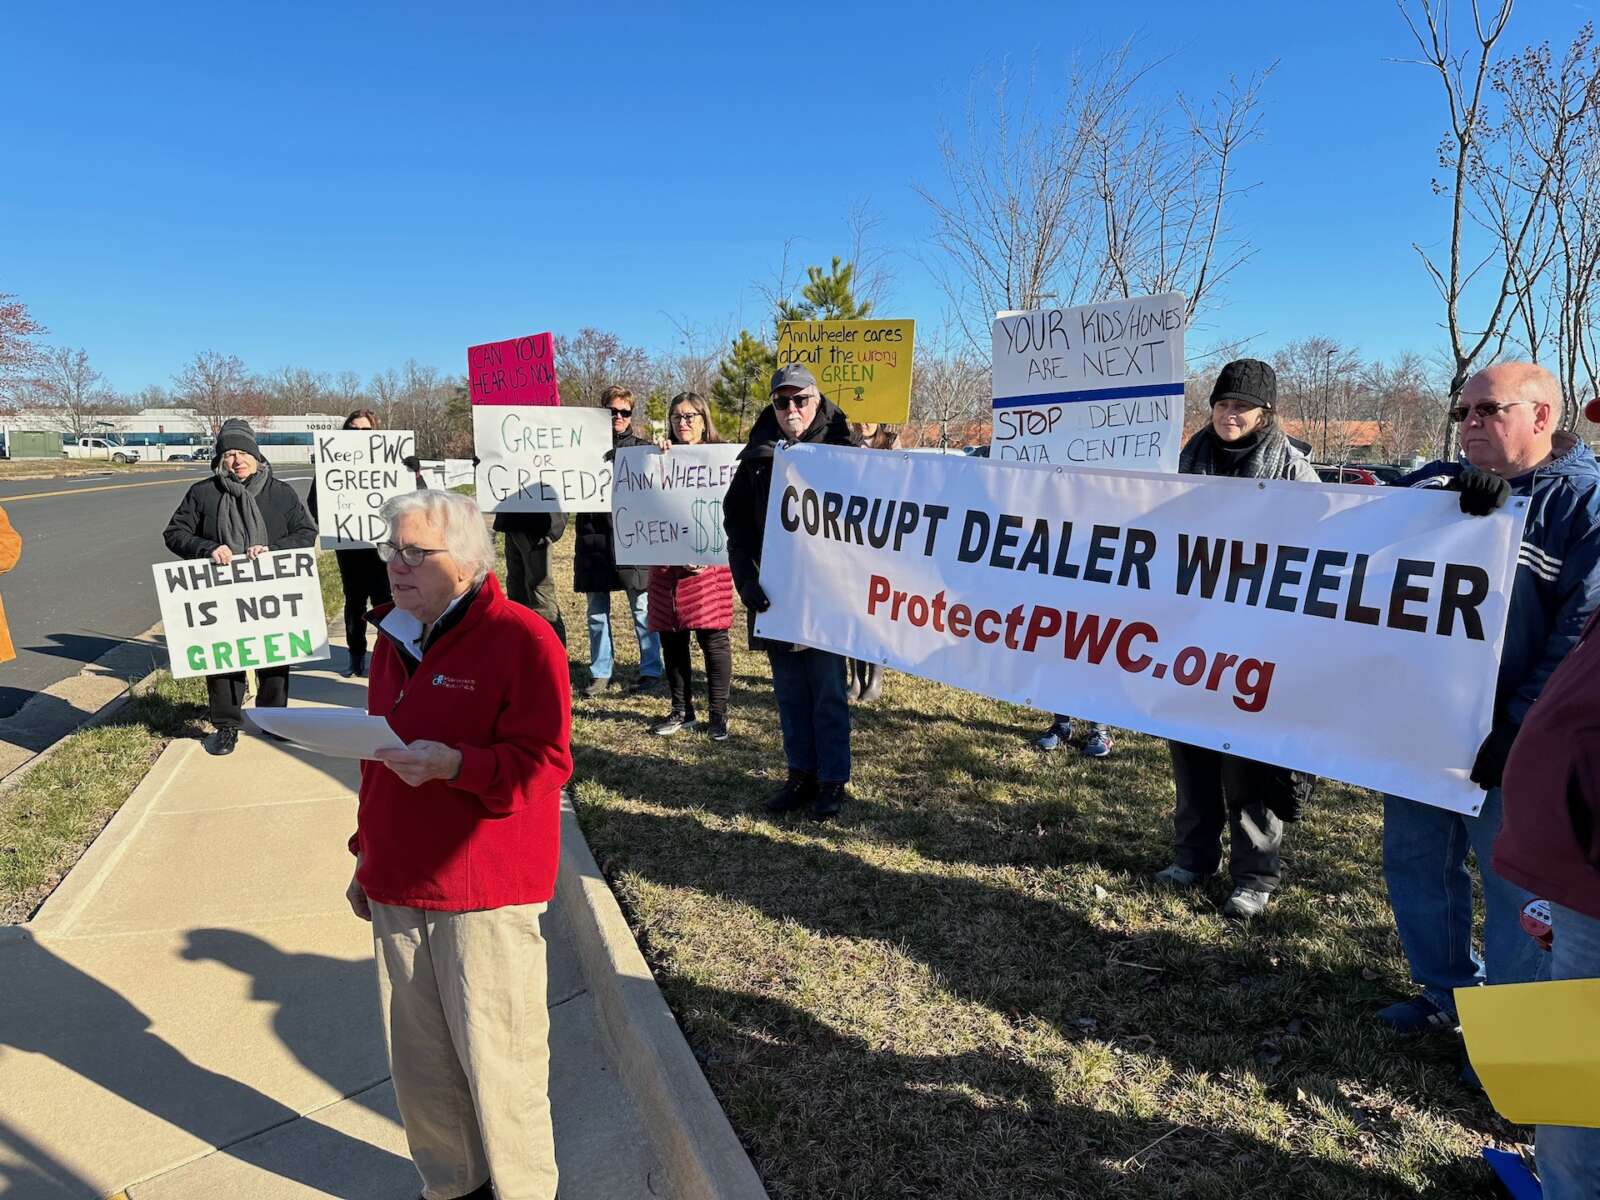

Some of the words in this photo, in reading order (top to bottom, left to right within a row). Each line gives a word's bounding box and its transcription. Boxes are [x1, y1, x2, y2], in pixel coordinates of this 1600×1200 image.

[863, 328, 903, 343] cares
[1001, 309, 1070, 354] YOUR
[1080, 304, 1182, 345] KIDS/HOMES
[472, 344, 503, 368] CAN
[512, 336, 547, 361] YOU
[779, 343, 823, 364] about
[830, 345, 854, 364] the
[858, 349, 897, 368] wrong
[1027, 357, 1068, 384] ARE
[1082, 340, 1165, 378] NEXT
[821, 364, 875, 383] GREEN
[501, 413, 583, 453] GREEN
[995, 406, 1063, 441] STOP
[1088, 398, 1169, 430] DEVLIN
[369, 434, 414, 465] PWC
[532, 454, 554, 468] OR
[1001, 444, 1050, 463] DATA
[1067, 431, 1161, 463] CENTER
[325, 468, 398, 492] GREEN
[487, 464, 612, 503] GREED?
[614, 455, 654, 492] ANN
[334, 513, 388, 543] KID
[164, 553, 314, 593] WHEELER
[780, 485, 949, 557] CORRUPT
[957, 509, 1157, 590] DEALER
[1175, 533, 1490, 641] WHEELER
[184, 600, 218, 628] IS
[235, 593, 303, 623] NOT
[186, 629, 314, 671] GREEN
[867, 574, 1276, 713] ProtectPWC.org
